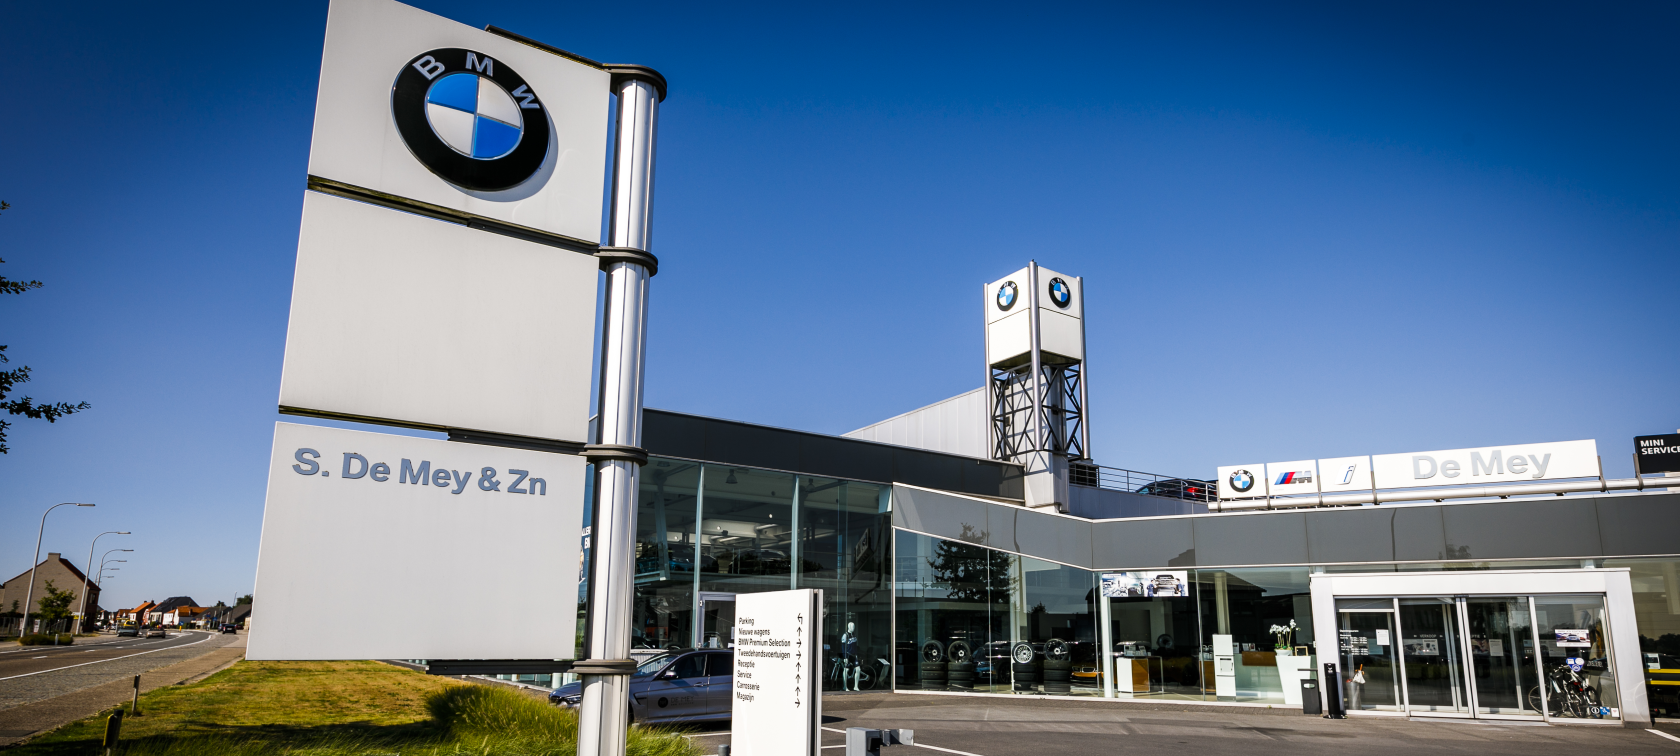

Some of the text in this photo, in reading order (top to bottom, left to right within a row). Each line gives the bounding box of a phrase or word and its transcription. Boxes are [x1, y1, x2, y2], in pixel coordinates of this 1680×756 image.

[412, 51, 541, 109] BMW
[1640, 439, 1664, 447] MINI
[1412, 450, 1552, 480] De Mey
[292, 448, 547, 495] S. De Mey & Zn
[738, 617, 754, 626] Parking
[754, 629, 770, 637] wagens
[750, 638, 768, 646] Premium
[769, 638, 790, 647] Selection
[738, 649, 790, 660] Tweedehandsvoertuigen
[738, 659, 755, 668] Receptie
[737, 670, 752, 678] Service
[737, 681, 760, 690] Carrosserie
